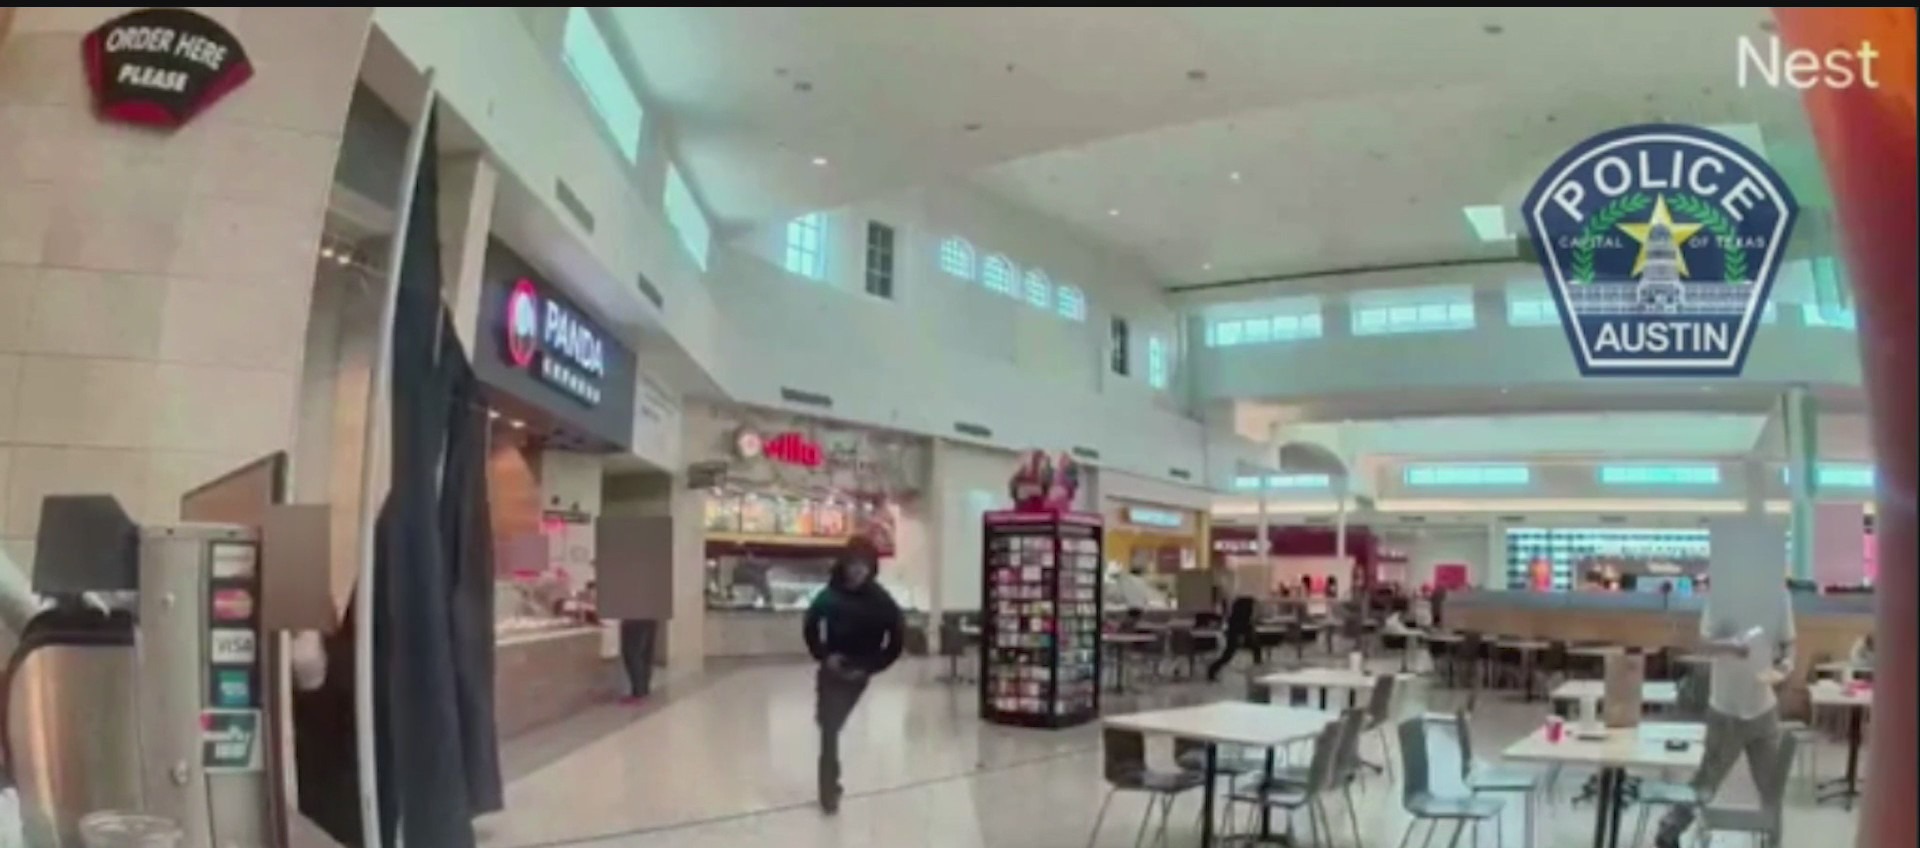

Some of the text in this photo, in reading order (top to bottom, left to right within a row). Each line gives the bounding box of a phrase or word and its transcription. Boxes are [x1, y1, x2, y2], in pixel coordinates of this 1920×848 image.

[106, 27, 226, 70] ORDER HERE
[118, 63, 188, 92] PLEASE
[544, 298, 603, 378] PANDA
